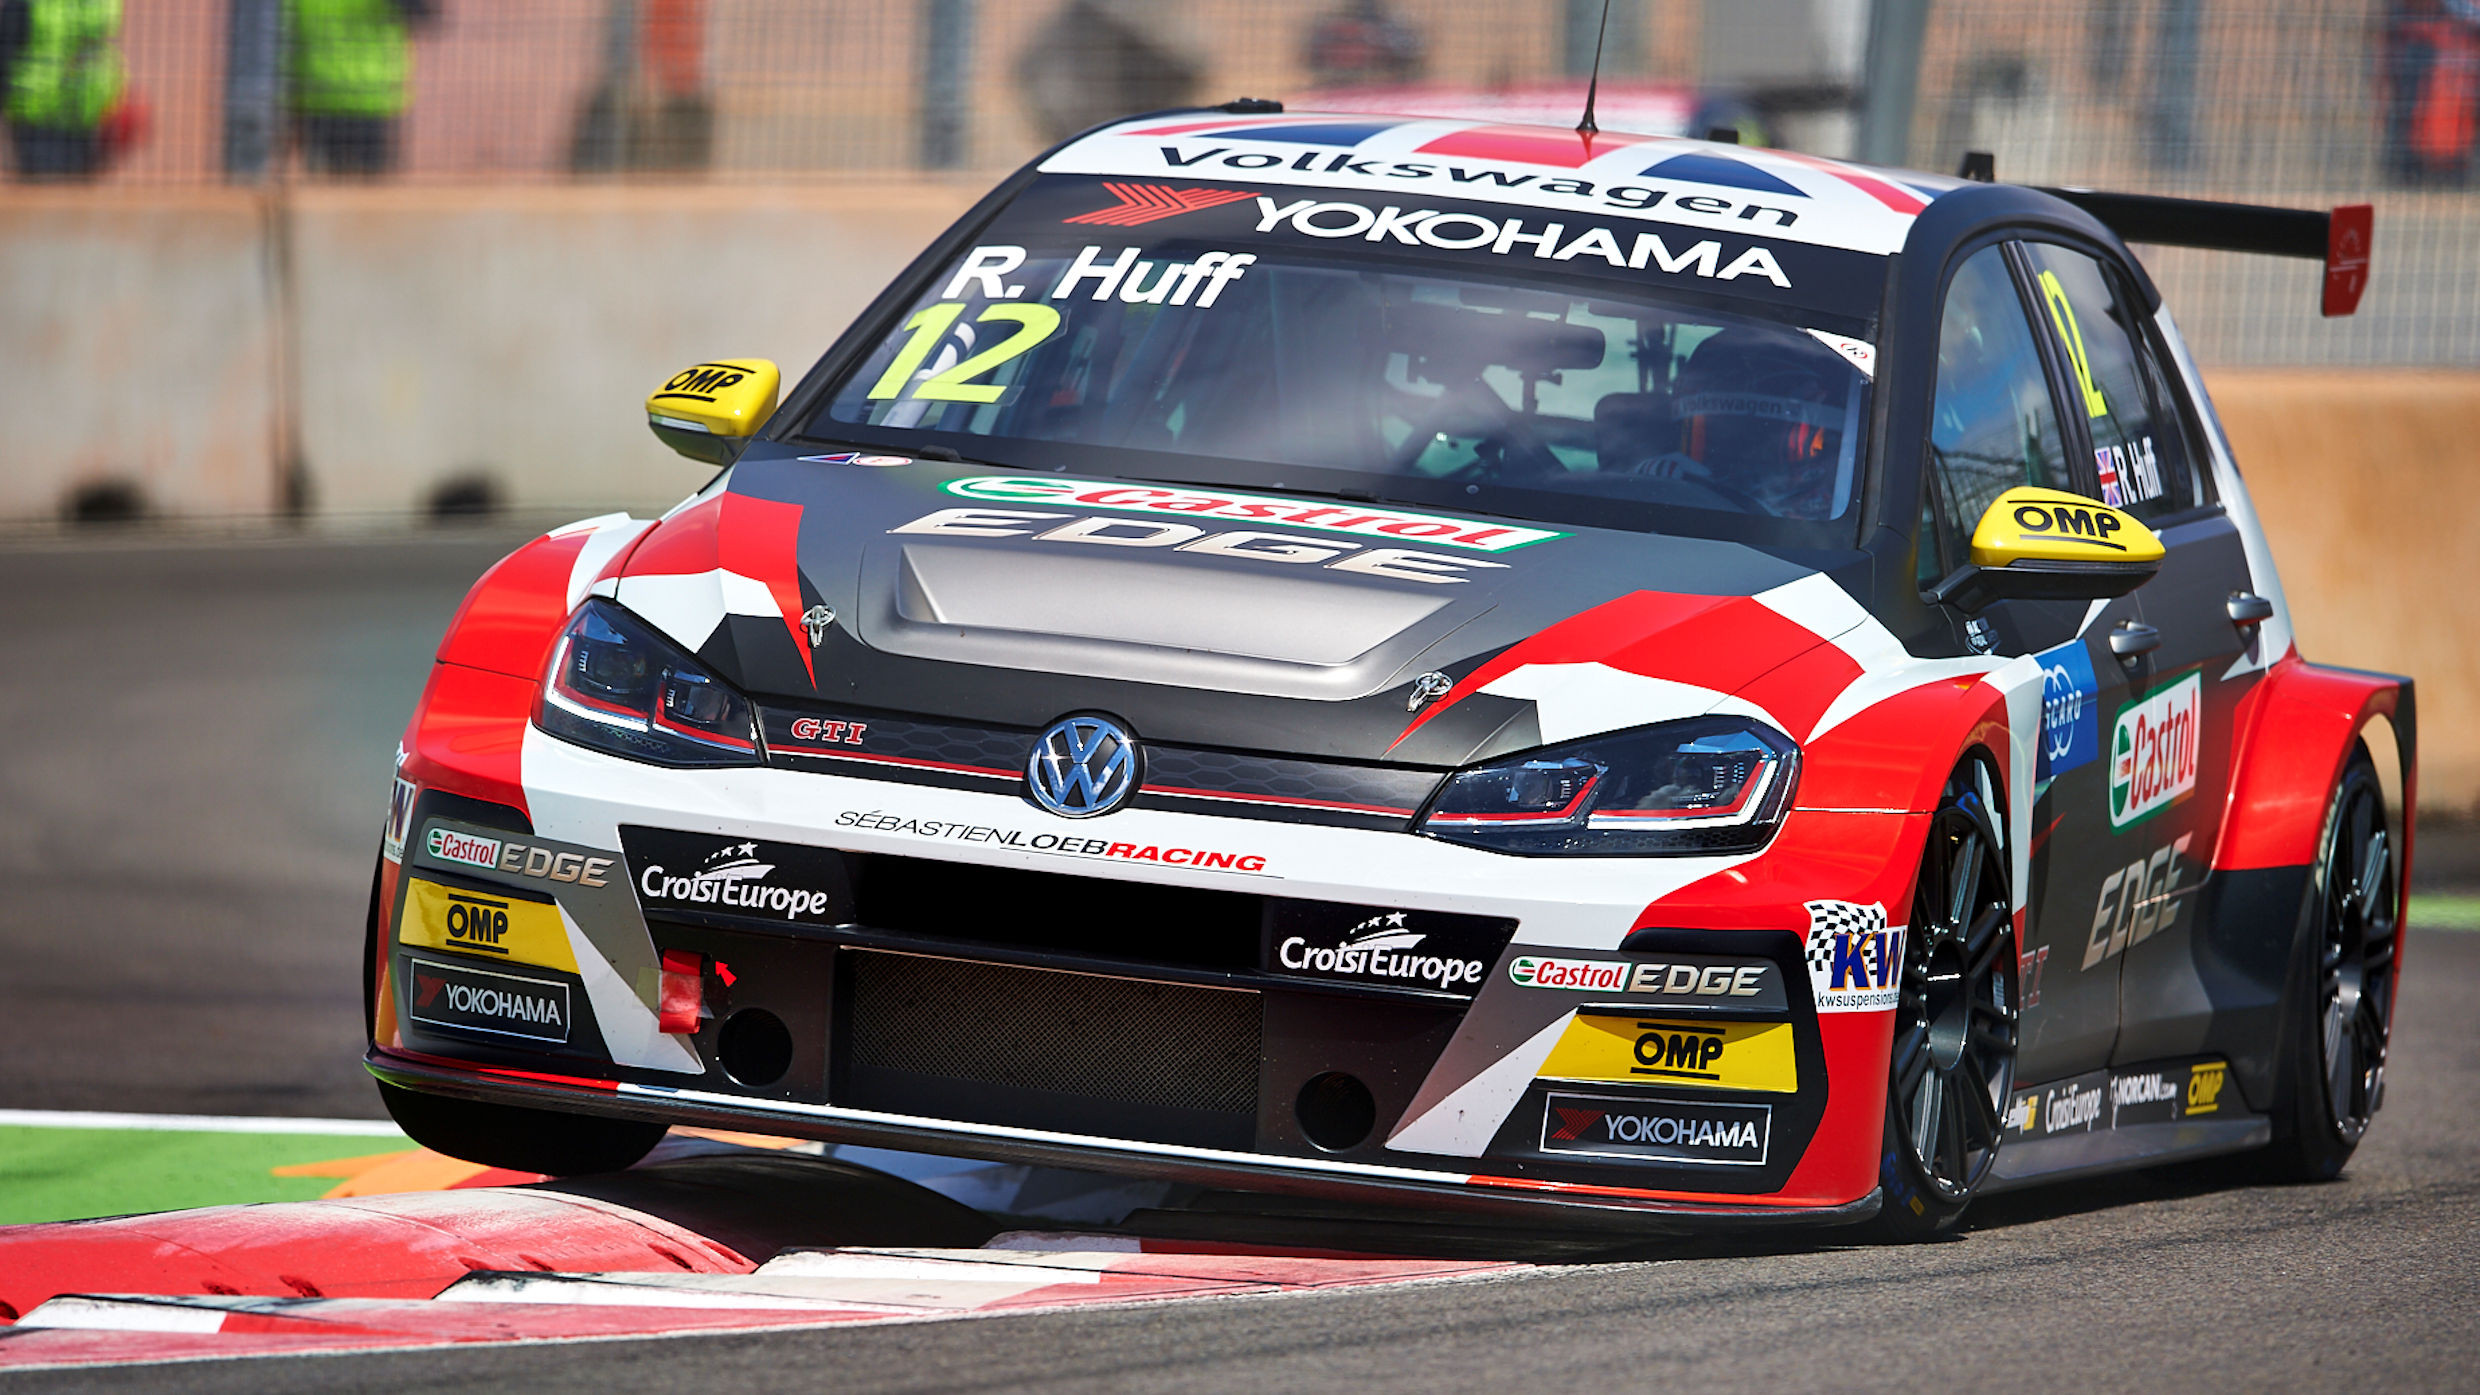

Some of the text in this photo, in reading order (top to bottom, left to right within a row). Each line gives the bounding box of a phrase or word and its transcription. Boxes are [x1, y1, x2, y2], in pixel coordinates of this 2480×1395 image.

[1160, 145, 1801, 228] Volkswagen
[1256, 196, 1793, 289] YOKOHAMA
[941, 245, 1258, 309] R. Huff
[866, 302, 1062, 404] 12
[663, 367, 745, 397] OMP
[1072, 486, 1513, 549] Castrol
[2013, 505, 2121, 539] OMP
[885, 507, 1512, 585] EDGE
[790, 717, 867, 746] GTI
[2130, 687, 2197, 811] Castrol
[440, 831, 498, 867] Castrol
[499, 844, 616, 888] EDGE
[641, 865, 828, 920] CroisiEurope
[2080, 831, 2193, 973] EDGE
[446, 904, 509, 944] OMP
[1279, 936, 1484, 990] CroisiEurope
[1535, 960, 1769, 997] Castrol EDGE
[1828, 931, 1907, 992] KW
[444, 983, 562, 1027] YOKOHAMA
[1633, 1032, 1724, 1072] OMP
[2187, 1070, 2224, 1107] OMP
[1603, 1113, 1759, 1149] YOKOHAMA
